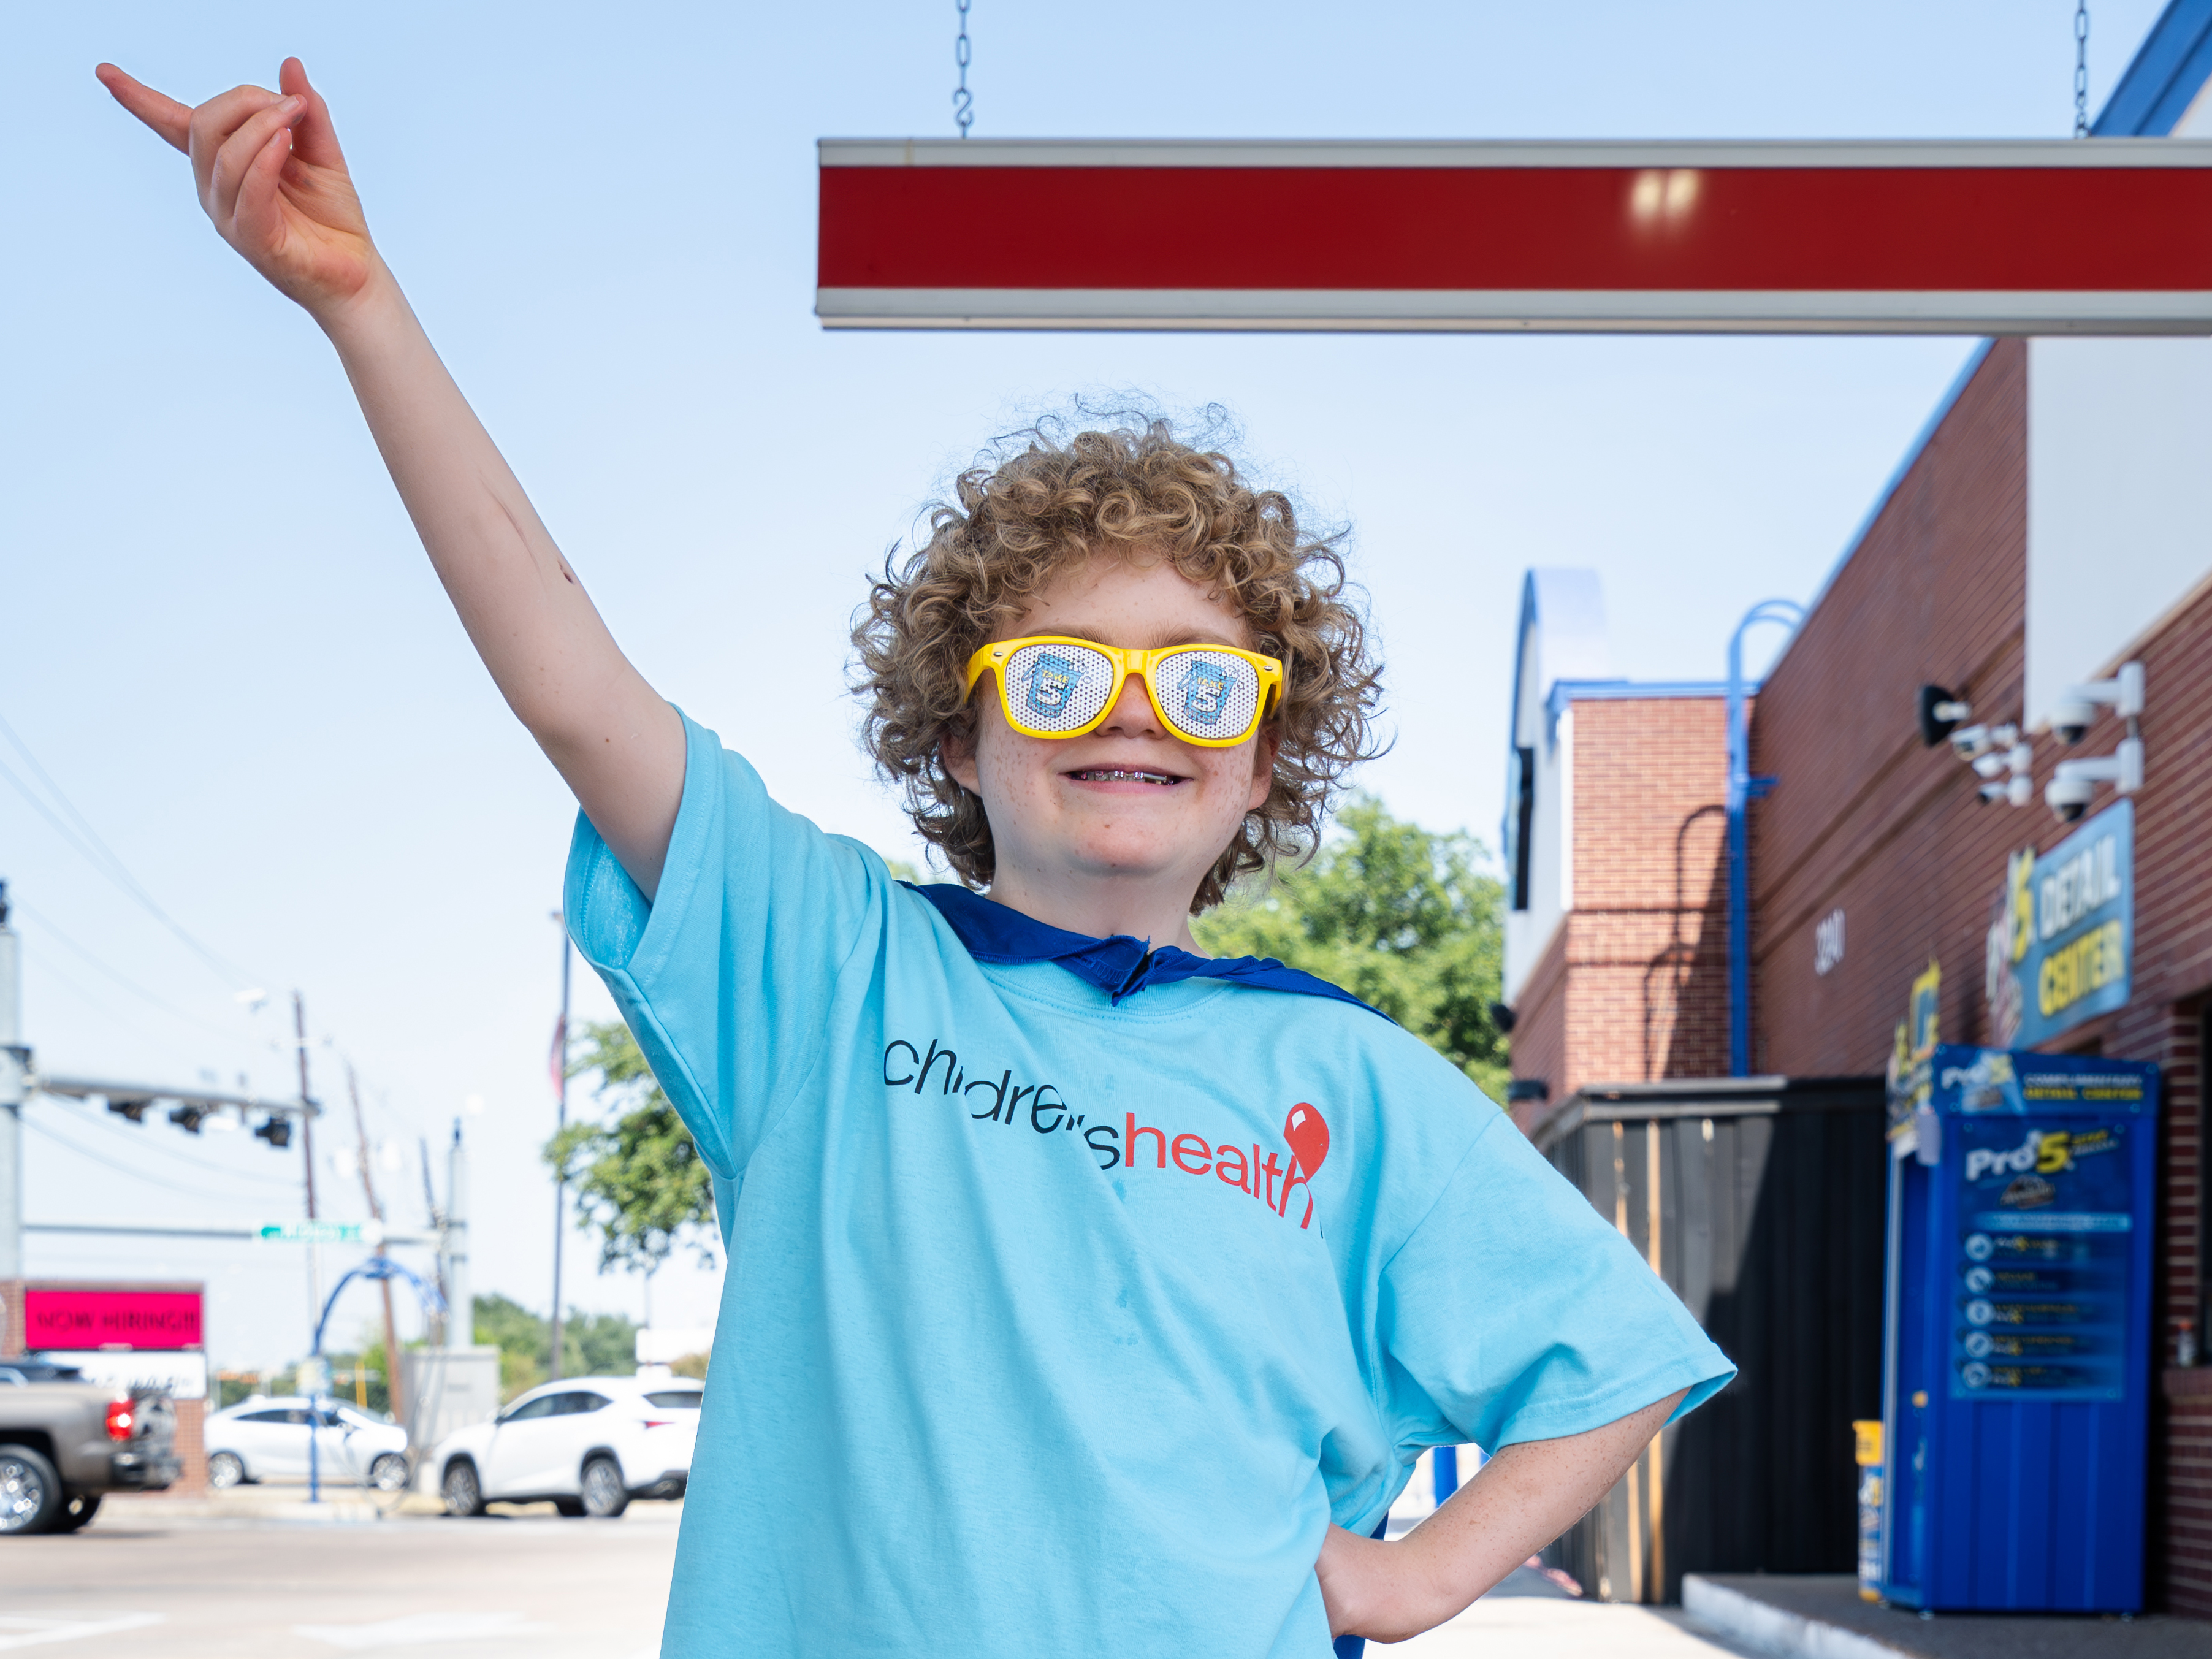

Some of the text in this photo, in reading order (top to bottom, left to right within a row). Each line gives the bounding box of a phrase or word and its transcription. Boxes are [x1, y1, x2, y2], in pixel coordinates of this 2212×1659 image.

[1035, 677, 1066, 706] 5
[1197, 677, 1224, 691] TAKE
[1192, 685, 1221, 712] 5
[2040, 835, 2121, 940] DETAIL
[2038, 919, 2124, 1018] CENTER
[36, 1309, 95, 1333] NOW
